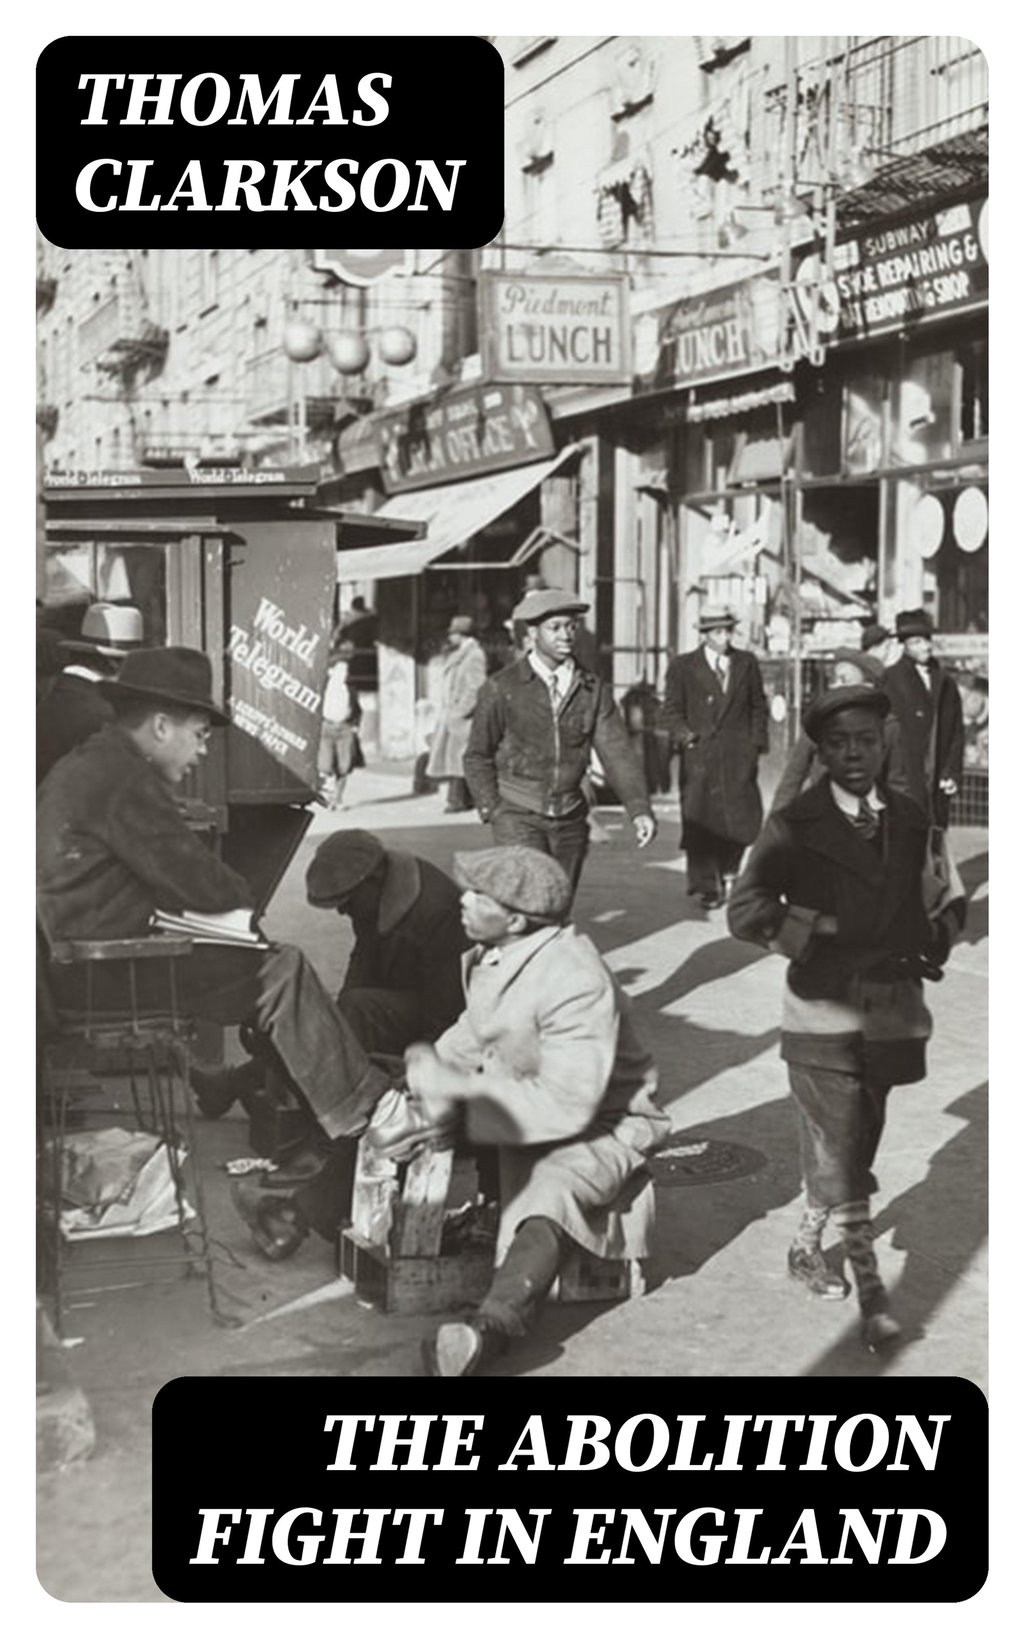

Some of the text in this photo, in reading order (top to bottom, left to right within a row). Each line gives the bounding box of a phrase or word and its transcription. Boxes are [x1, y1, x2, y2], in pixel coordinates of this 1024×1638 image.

[866, 220, 929, 256] SUBWAY
[877, 239, 963, 286] REPAIRING
[963, 234, 977, 261] &
[501, 284, 613, 316] Piedmont
[507, 325, 612, 363] LUNCH
[447, 415, 514, 463] OFFCE
[254, 597, 320, 668] World
[230, 624, 321, 713] Telegram
